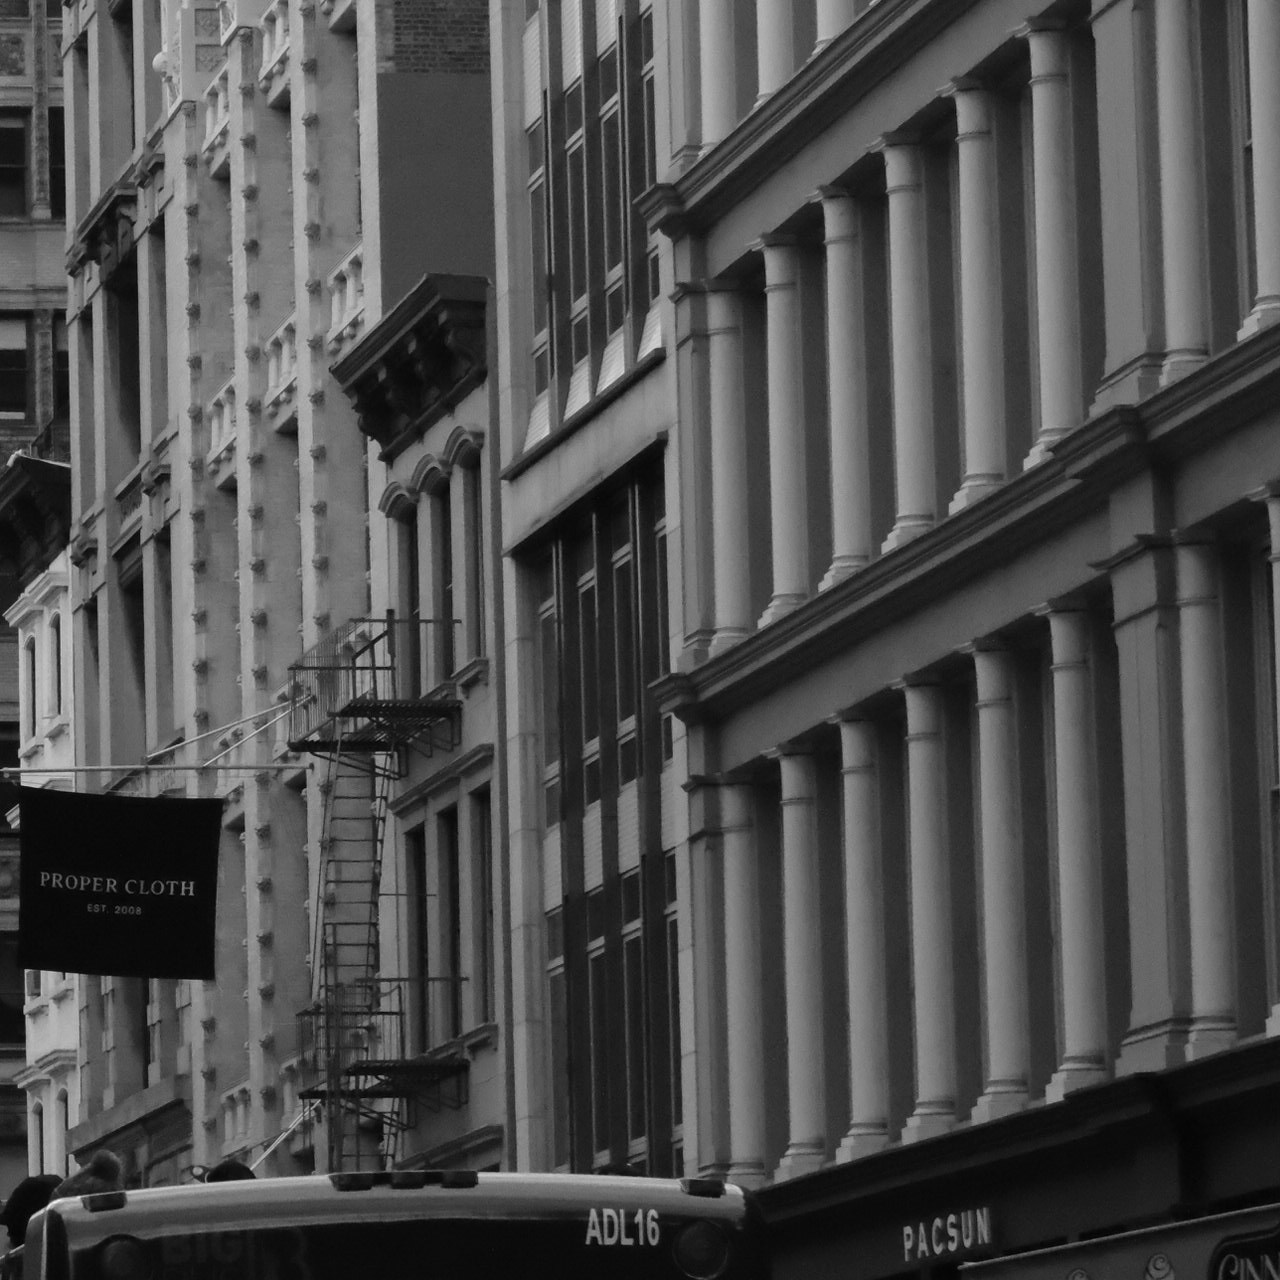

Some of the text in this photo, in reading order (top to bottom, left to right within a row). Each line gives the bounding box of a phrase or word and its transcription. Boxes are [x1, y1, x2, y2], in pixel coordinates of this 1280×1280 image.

[39, 871, 195, 897] PROPER CLOTH
[86, 903, 143, 916] EST. 2008
[585, 1207, 660, 1246] ADL16
[902, 1207, 992, 1262] PACSUN
